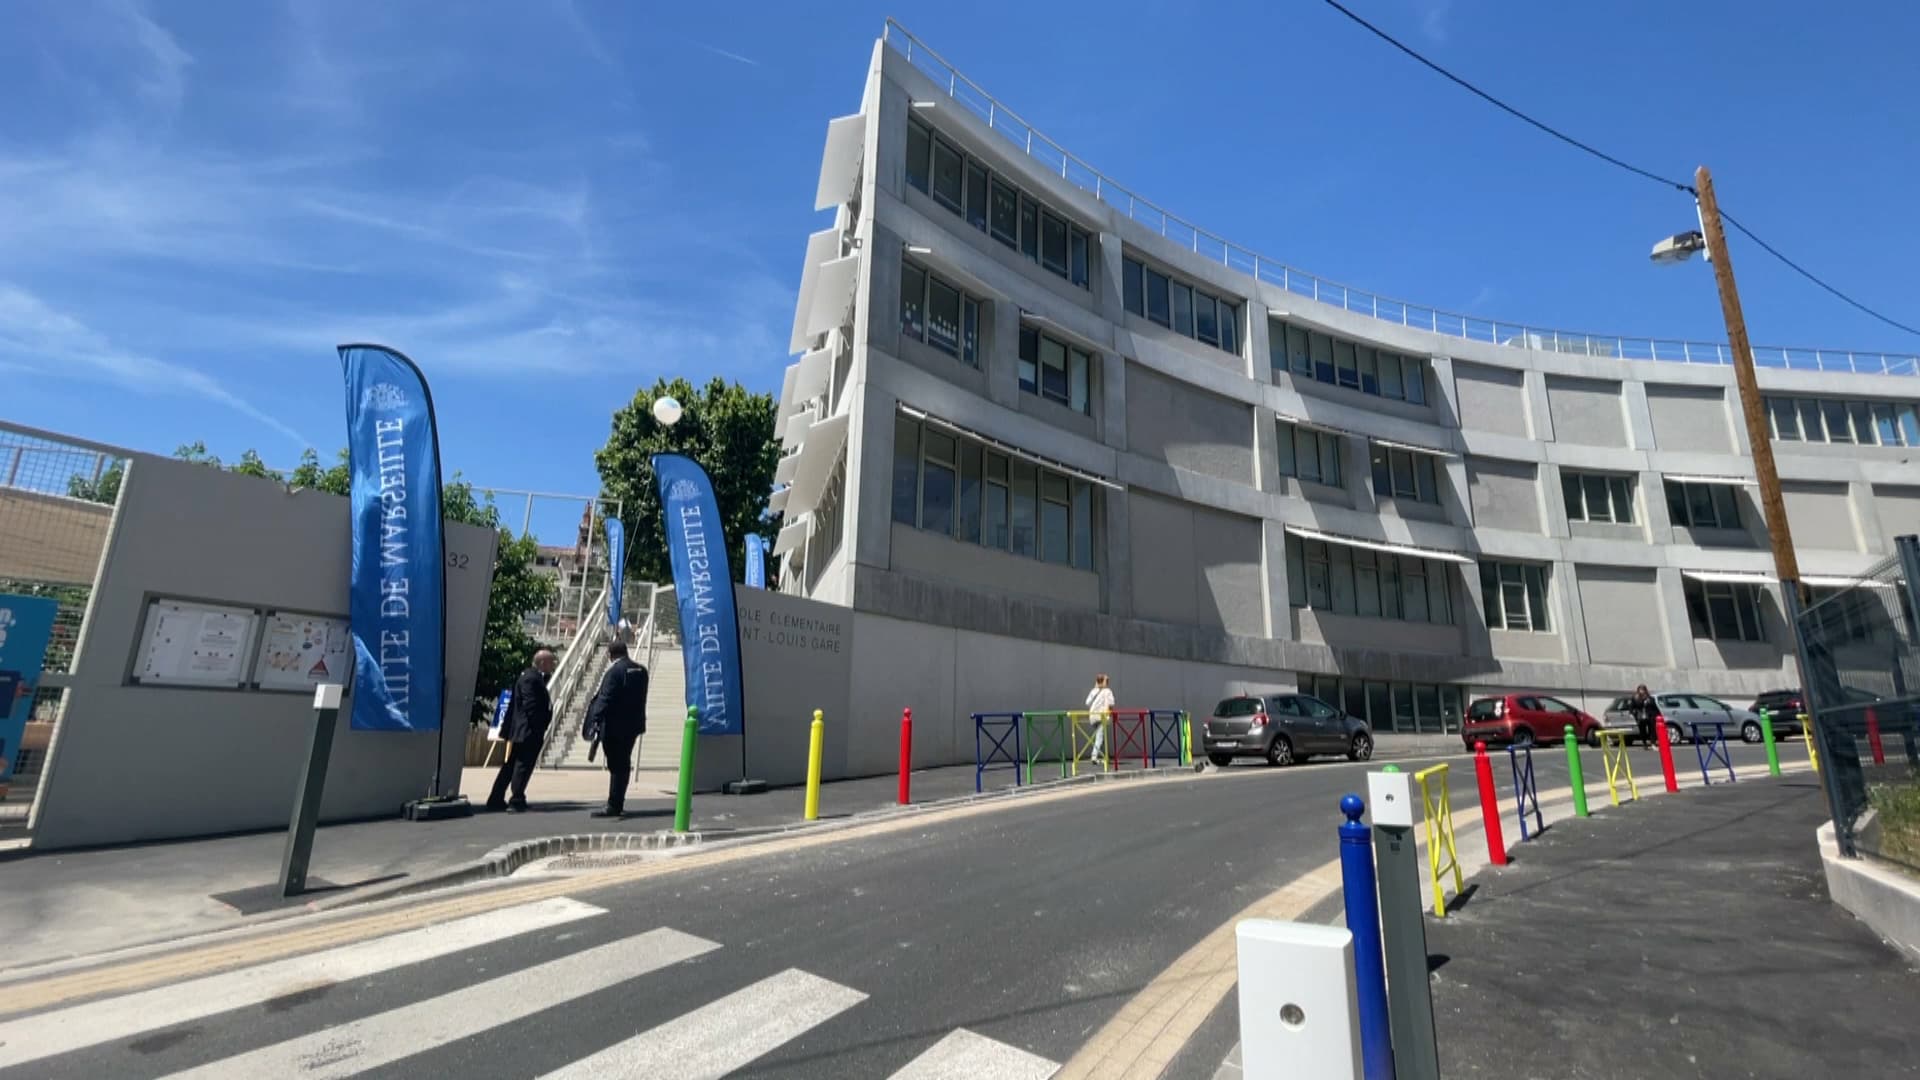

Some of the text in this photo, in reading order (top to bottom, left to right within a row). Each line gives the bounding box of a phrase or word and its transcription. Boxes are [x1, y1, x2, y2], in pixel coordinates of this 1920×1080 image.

[447, 551, 469, 569] 32
[739, 607, 760, 622] OLE
[811, 636, 841, 653] GARE
